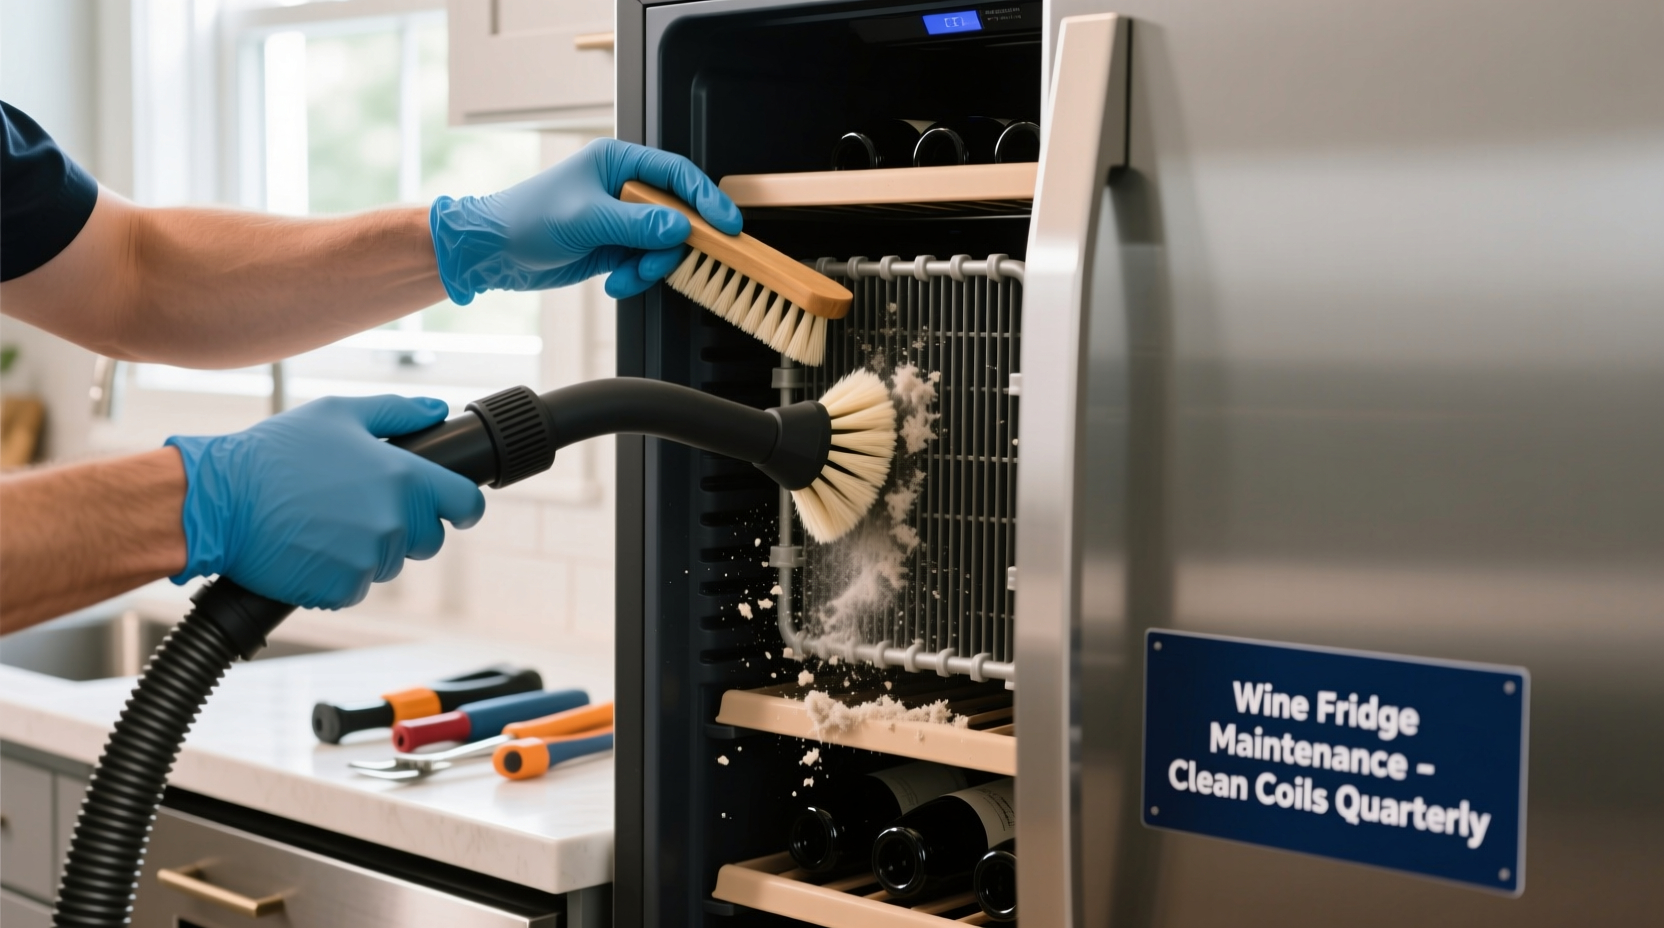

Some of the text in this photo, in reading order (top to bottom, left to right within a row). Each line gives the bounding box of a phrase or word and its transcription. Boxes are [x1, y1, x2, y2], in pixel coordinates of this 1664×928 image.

[1232, 680, 1420, 741] Wine Fridge
[1209, 721, 1409, 781] Maintenance
[1168, 758, 1492, 849] Clean Coils Quarterly
